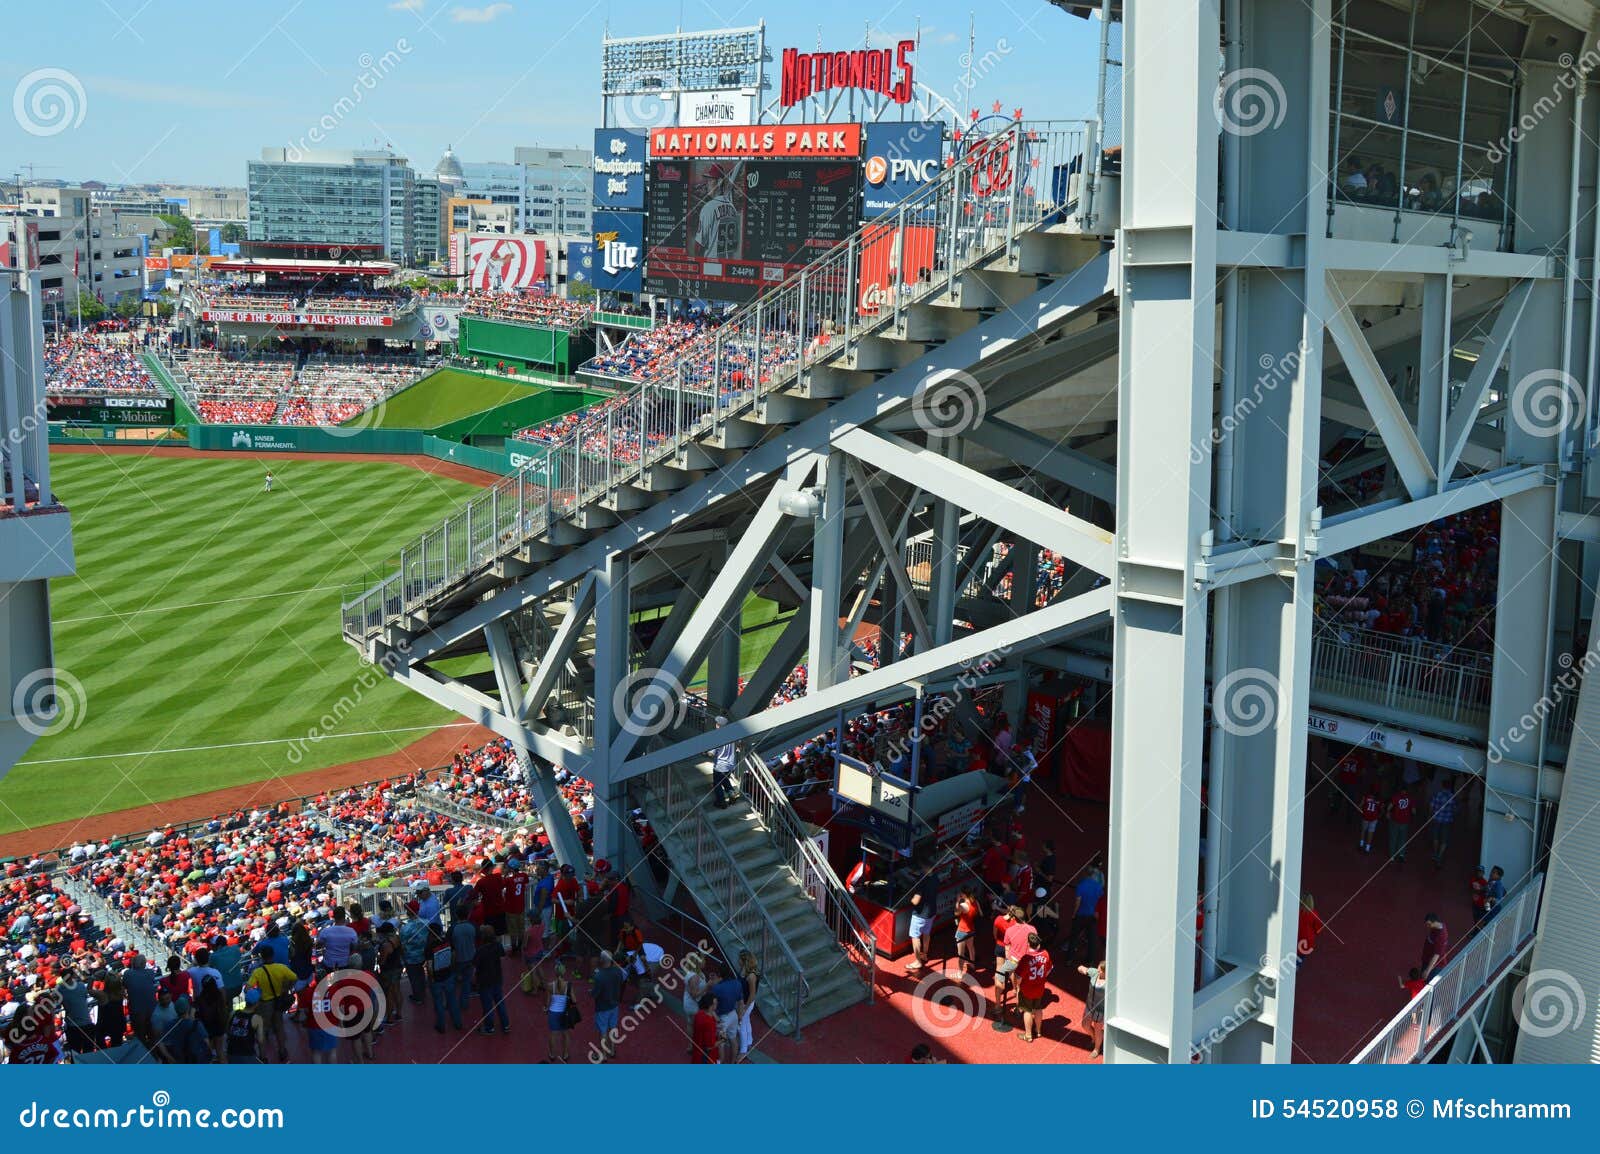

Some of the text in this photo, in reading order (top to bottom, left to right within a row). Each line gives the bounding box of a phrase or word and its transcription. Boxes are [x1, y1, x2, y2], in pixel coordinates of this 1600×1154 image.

[781, 40, 914, 106] NATIONALS
[695, 104, 734, 121] CHAMPIONS
[656, 131, 846, 150] NATIONALS PARK
[595, 156, 642, 176] Washington
[890, 160, 938, 182] PNC
[608, 178, 627, 196] Post
[602, 240, 639, 275] Lite
[208, 311, 236, 322] HOME
[237, 312, 249, 322] OF
[251, 313, 268, 323] THE
[270, 313, 292, 323] 2018
[358, 316, 384, 327] GAME
[137, 399, 167, 408] FAN
[883, 790, 902, 808] 222
[1029, 964, 1045, 980] 34
